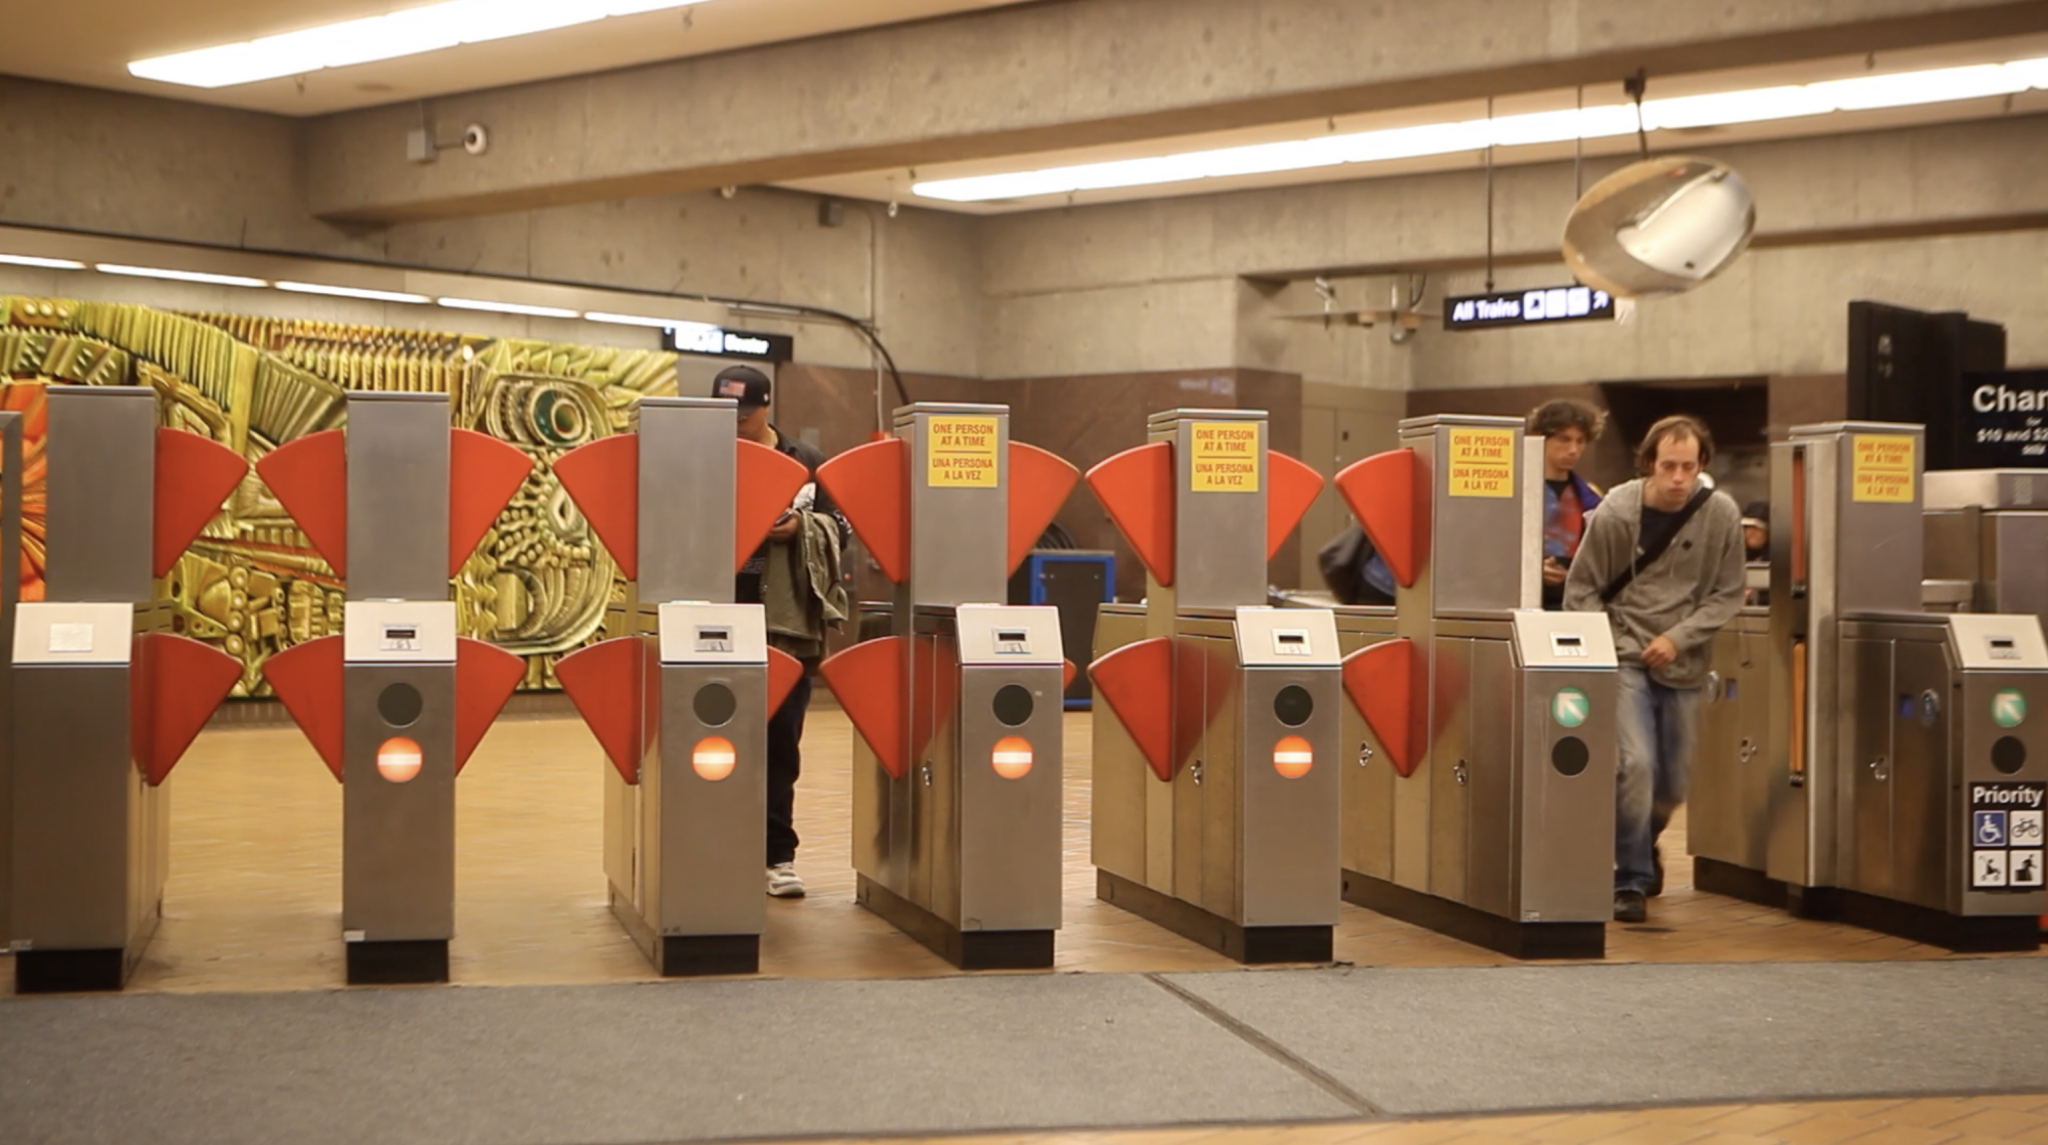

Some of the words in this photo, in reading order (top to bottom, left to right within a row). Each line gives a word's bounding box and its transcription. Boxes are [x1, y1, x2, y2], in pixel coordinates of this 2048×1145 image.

[1453, 300, 1475, 321] All
[1476, 298, 1520, 319] Trains
[933, 424, 953, 434] ONE
[955, 424, 994, 434] PERSON
[1196, 429, 1214, 439] ONE
[1217, 430, 1254, 440] PERSON
[2004, 427, 2031, 442] and
[941, 436, 952, 446] AT
[954, 436, 961, 446] A
[963, 436, 986, 447] TIME
[1454, 435, 1471, 445] ONE
[1474, 436, 1510, 446] PERSON
[1203, 441, 1214, 452] AT
[1216, 441, 1223, 451] A
[1225, 441, 1247, 452] TIME
[1461, 447, 1471, 457] AT
[1473, 447, 1479, 457] A
[1481, 448, 1502, 458] TIME
[932, 458, 950, 468] UNA
[953, 458, 993, 468] PERSONA
[1195, 463, 1213, 473] UNA
[1215, 463, 1254, 473] PERSONA
[944, 470, 950, 480] A
[952, 470, 963, 480] LA
[965, 470, 981, 480] VEZ
[1453, 469, 1469, 478] UNA
[1472, 469, 1509, 479] PERSONA
[1206, 475, 1213, 485] A
[1214, 475, 1226, 485] LA
[1227, 475, 1243, 485] VEZ
[1463, 480, 1469, 489] A
[1471, 480, 1481, 490] LA
[1483, 480, 1498, 491] VEZ
[1973, 785, 2044, 808] Priority
